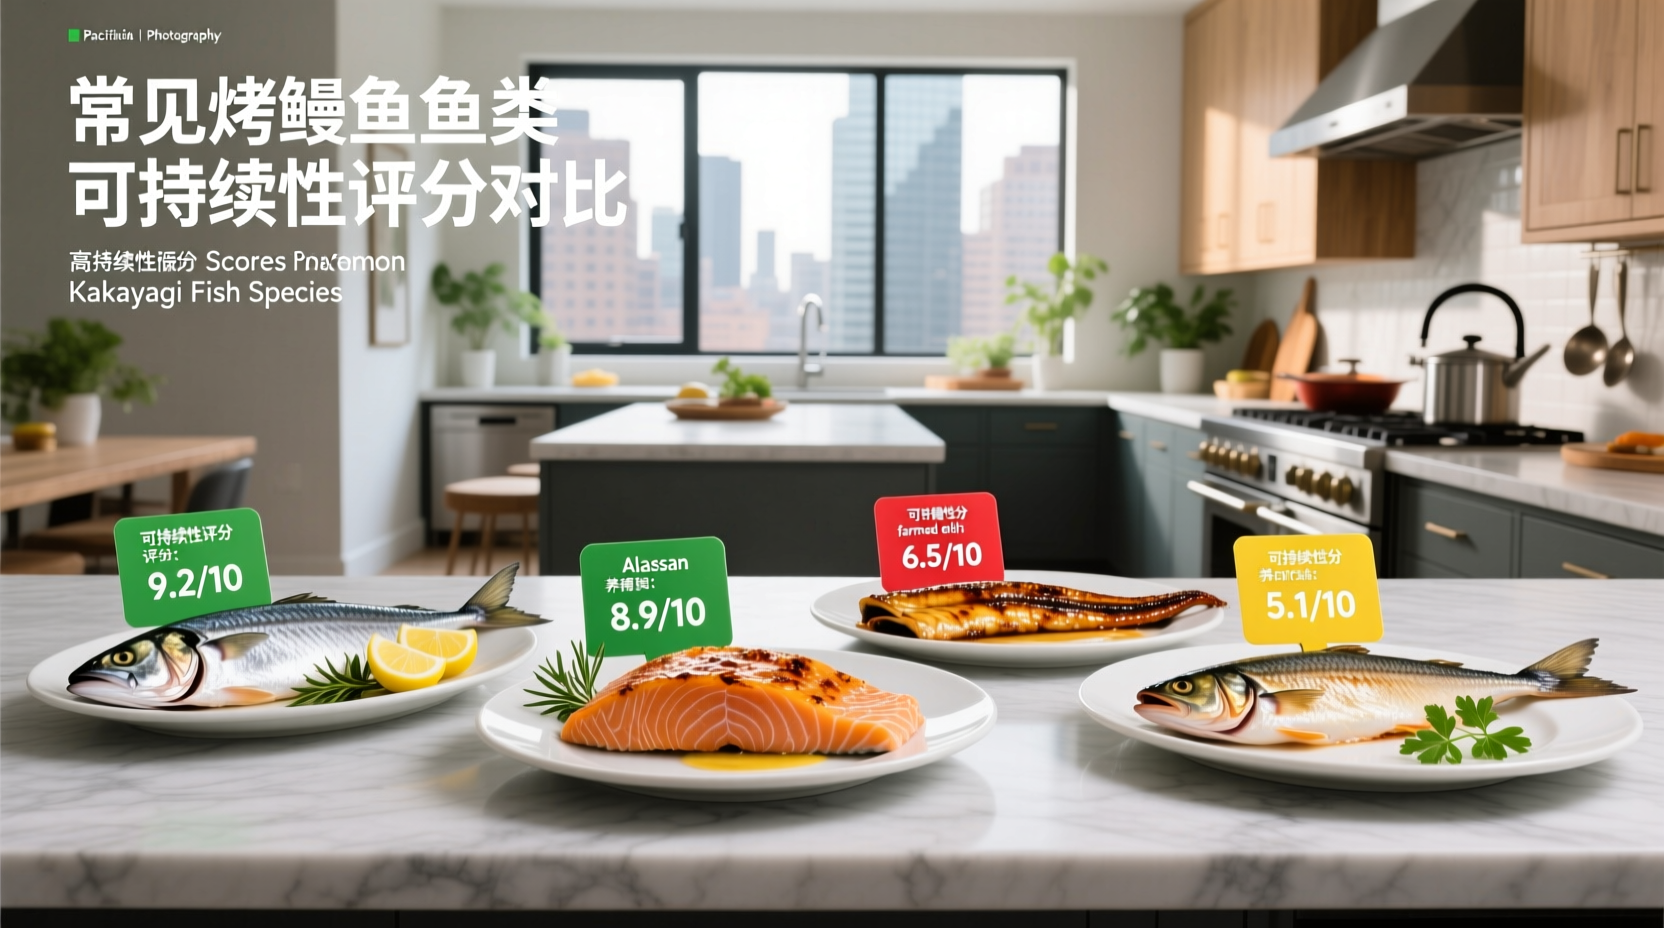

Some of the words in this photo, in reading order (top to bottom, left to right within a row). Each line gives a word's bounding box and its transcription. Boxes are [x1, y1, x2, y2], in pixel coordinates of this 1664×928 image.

[622, 556, 689, 573] Alassan
[902, 542, 982, 571] 6.5/10
[147, 563, 243, 600] 9.2/10
[610, 597, 706, 632] 8.9/10
[1267, 590, 1356, 623] 5.1/10
